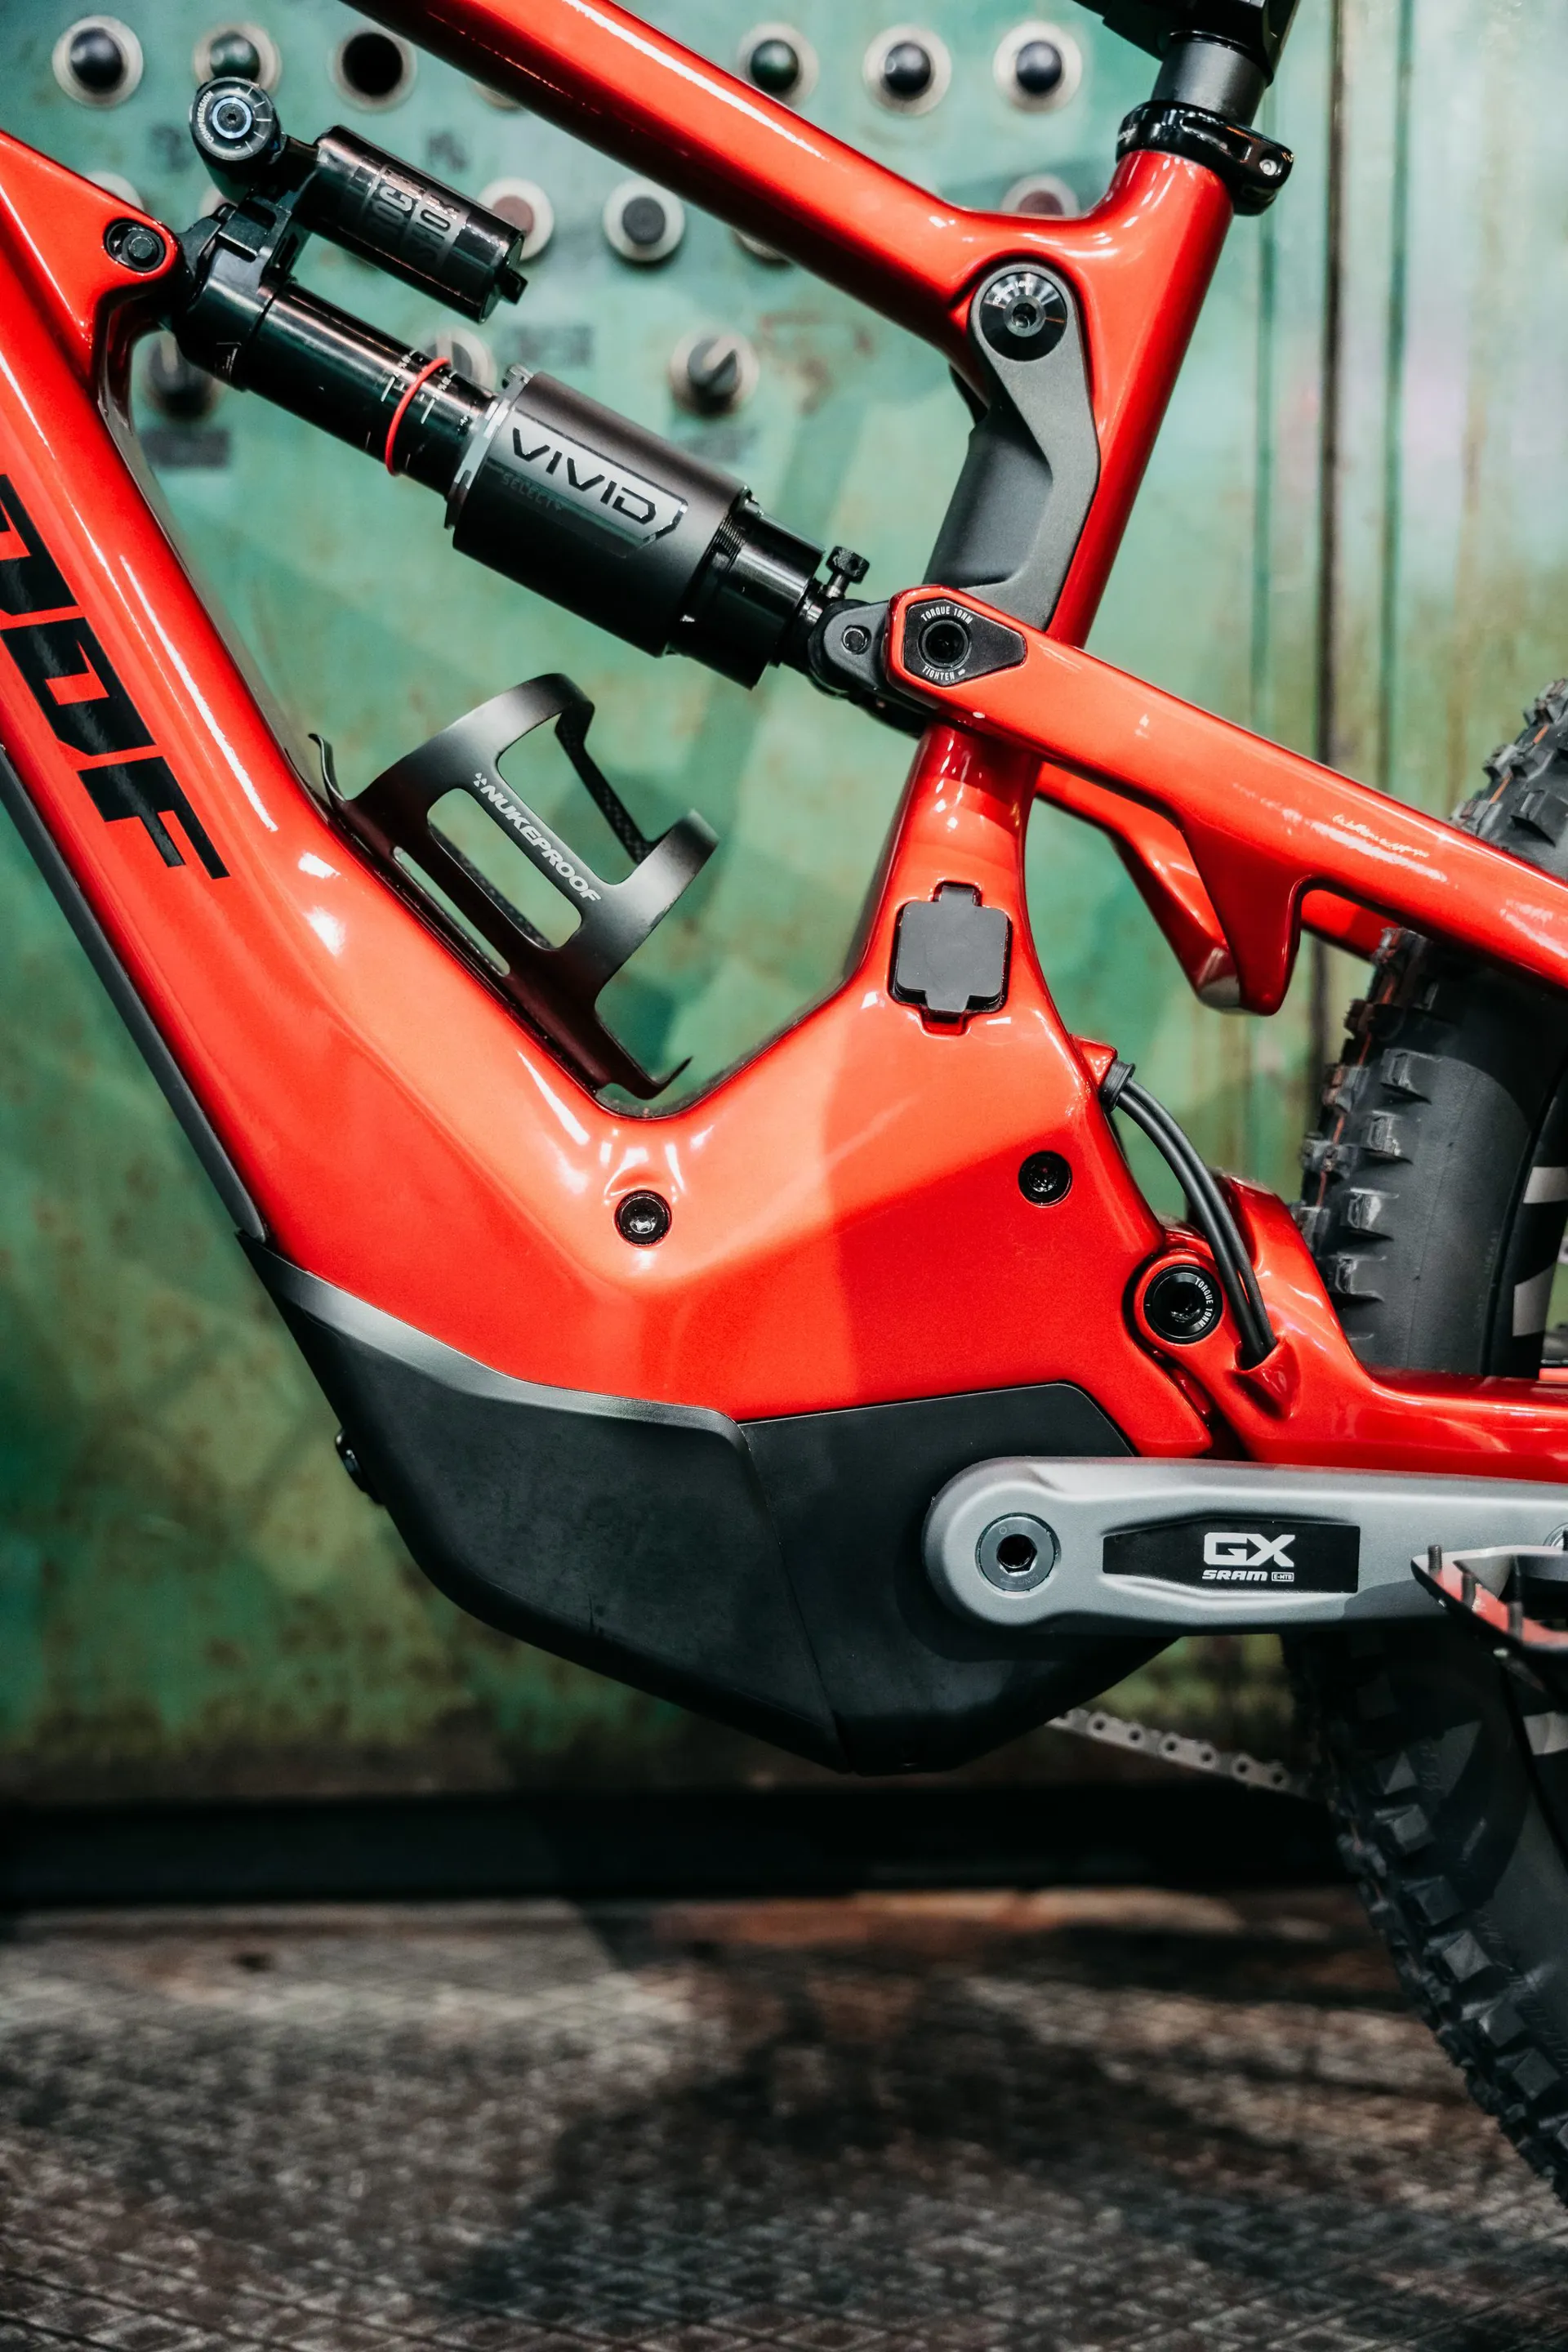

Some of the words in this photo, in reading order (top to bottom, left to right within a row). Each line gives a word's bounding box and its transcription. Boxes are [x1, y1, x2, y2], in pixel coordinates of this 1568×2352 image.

[196, 91, 214, 144] COMPRESSION
[512, 426, 657, 525] VIVID
[920, 606, 951, 622] TORQUE
[921, 665, 956, 681] TIGHTEN
[479, 785, 602, 902] NUKEPROOF
[1194, 1276, 1214, 1305] TORQUE
[1197, 1307, 1214, 1328] 19NM
[1203, 1531, 1296, 1567] GX
[1201, 1569, 1268, 1582] SRAM
[1272, 1573, 1294, 1581] E-MTB
